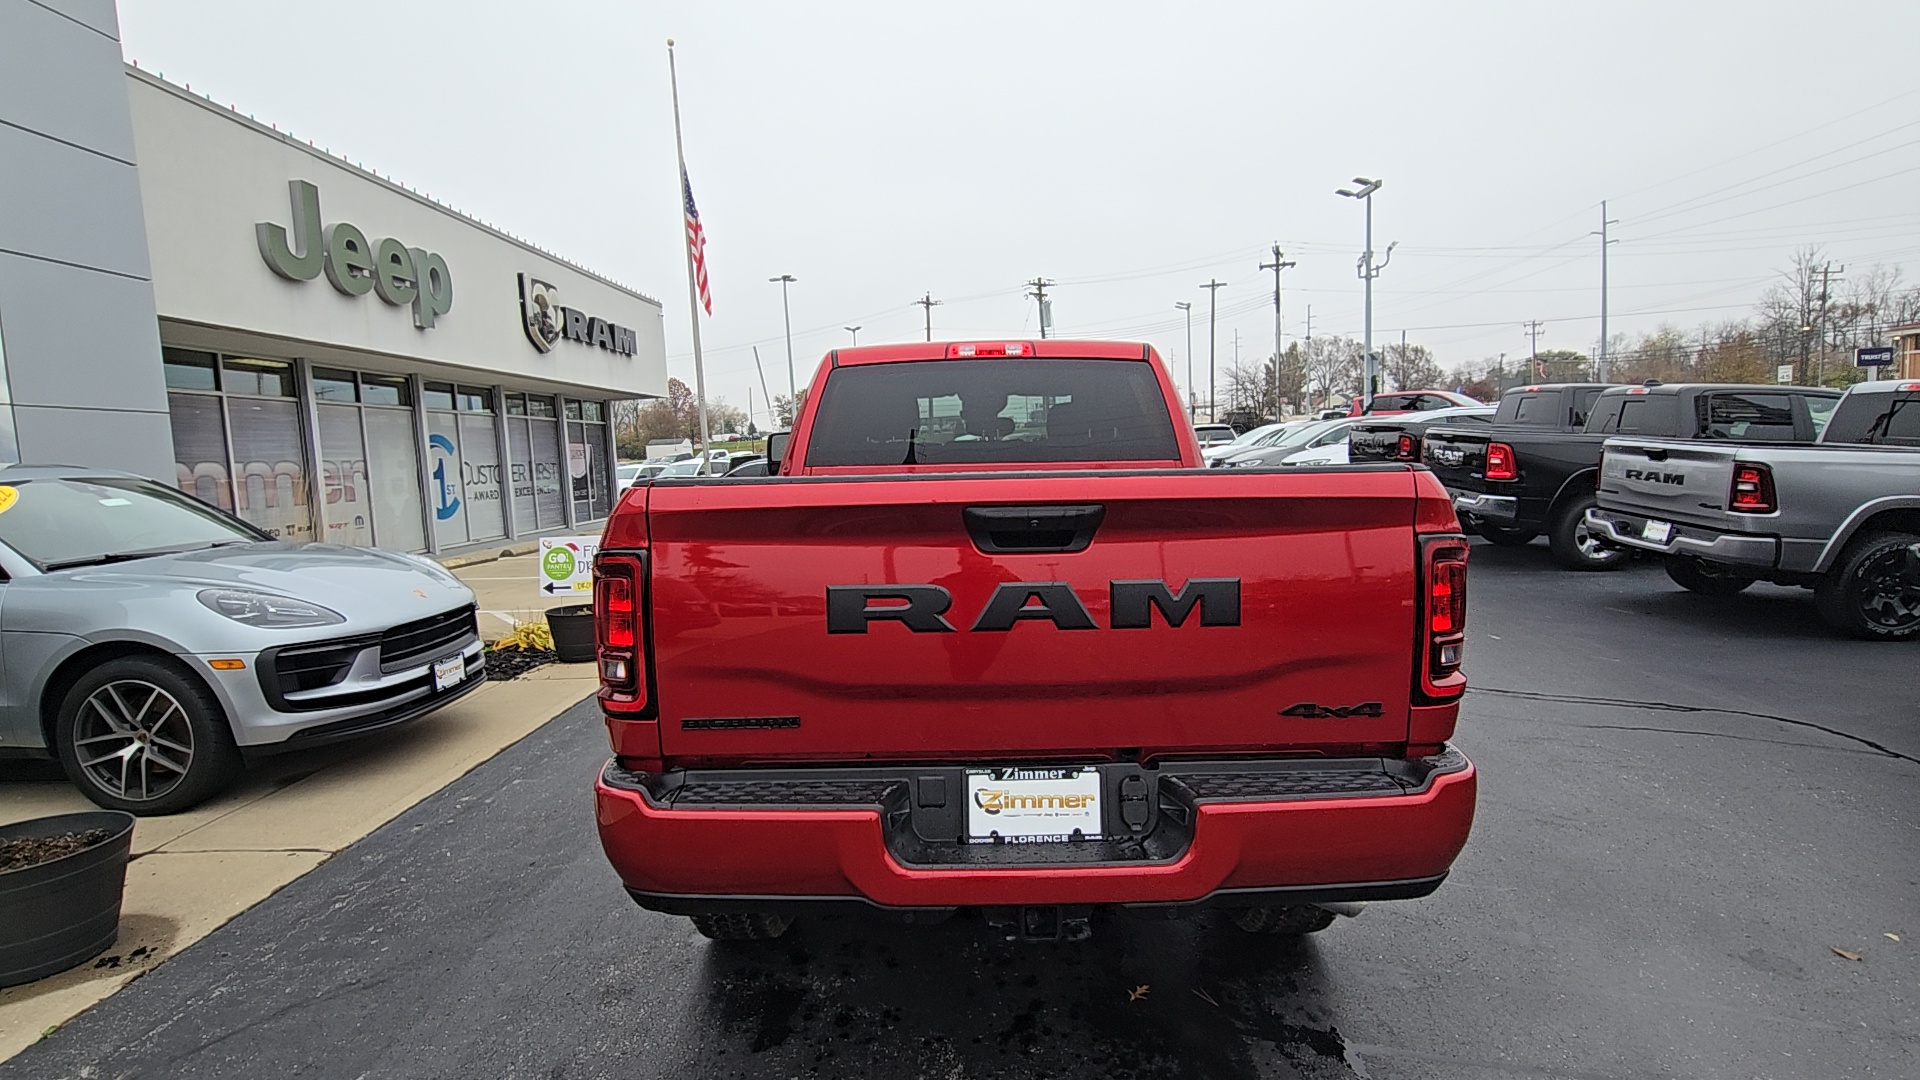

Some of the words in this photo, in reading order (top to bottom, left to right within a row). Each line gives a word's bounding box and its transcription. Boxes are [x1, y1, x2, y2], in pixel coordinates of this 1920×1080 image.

[255, 179, 453, 329] Jeep
[560, 305, 638, 357] RAM
[460, 461, 527, 486] CUSTOER
[1625, 469, 1685, 486] RAM
[473, 489, 499, 502] AWARD
[548, 553, 569, 563] GO!
[826, 577, 1241, 634] RAM
[1001, 767, 1066, 780] Zimmer
[981, 789, 1096, 810] Zimmer
[1004, 835, 1069, 844] FLORENCE
